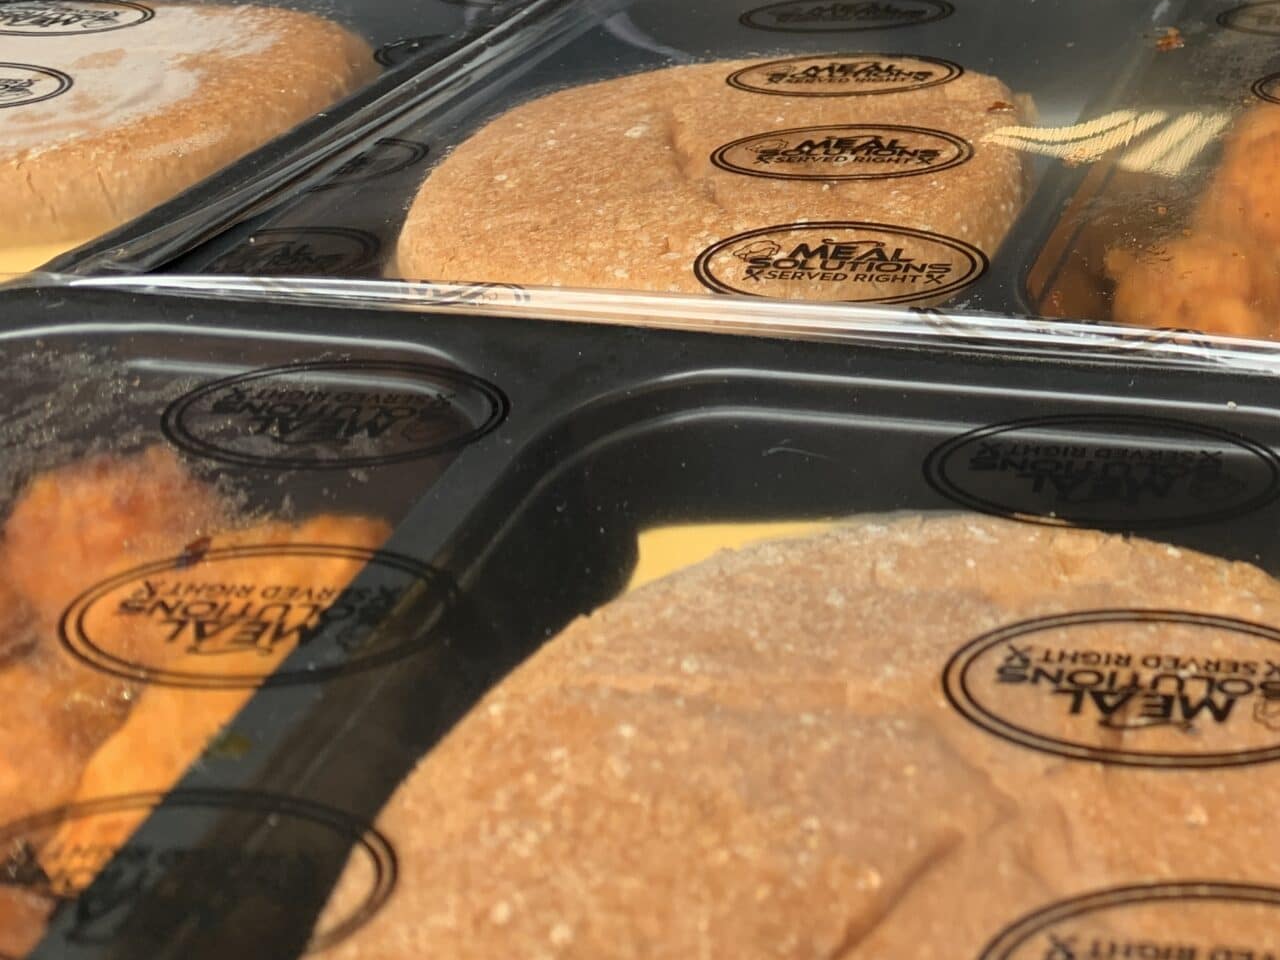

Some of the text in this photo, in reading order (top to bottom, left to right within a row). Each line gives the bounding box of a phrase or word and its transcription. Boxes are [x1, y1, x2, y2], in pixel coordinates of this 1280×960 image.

[800, 63, 905, 76] MEAL
[793, 138, 908, 151] MEAL
[757, 149, 940, 159] SOLUTIONS
[854, 156, 909, 164] RIGHT
[786, 243, 916, 262] MEAL
[746, 257, 953, 274] SOLUTIONS
[763, 270, 922, 282] SERVED RIGHT
[168, 581, 256, 597] RIGHT
[162, 619, 326, 645] MEAL
[1042, 649, 1260, 676] SERVED RIGHT
[1050, 688, 1239, 724] MEAL
